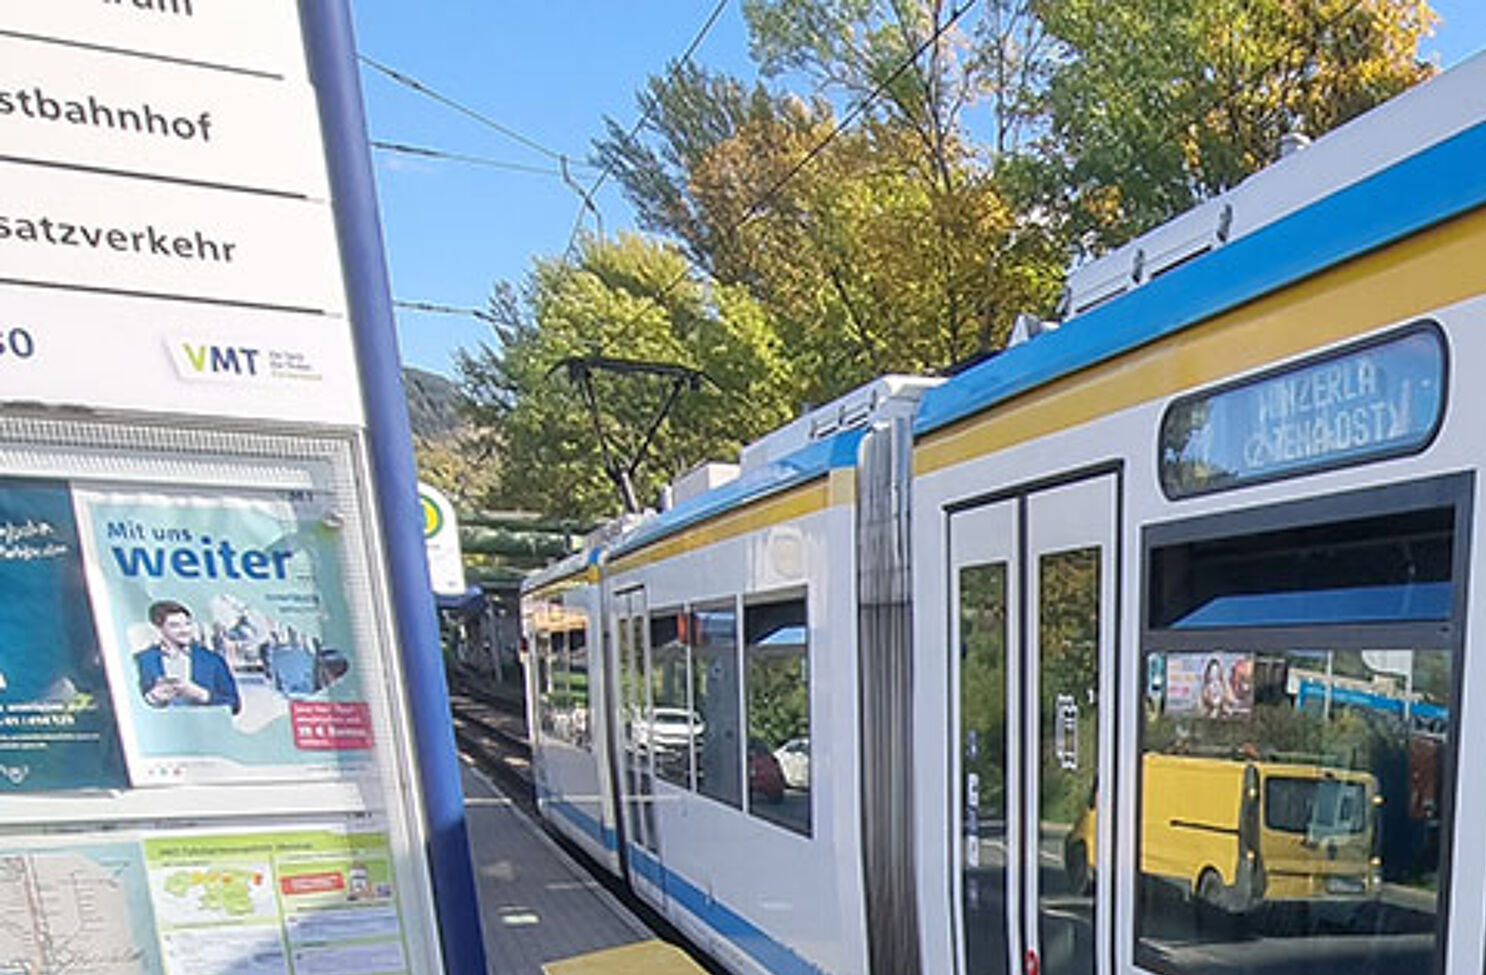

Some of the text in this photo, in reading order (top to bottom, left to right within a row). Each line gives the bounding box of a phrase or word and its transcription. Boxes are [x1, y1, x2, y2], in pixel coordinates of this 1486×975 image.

[183, 342, 260, 376] VMT
[107, 520, 193, 543] Mit uns
[111, 535, 293, 580] weiter
